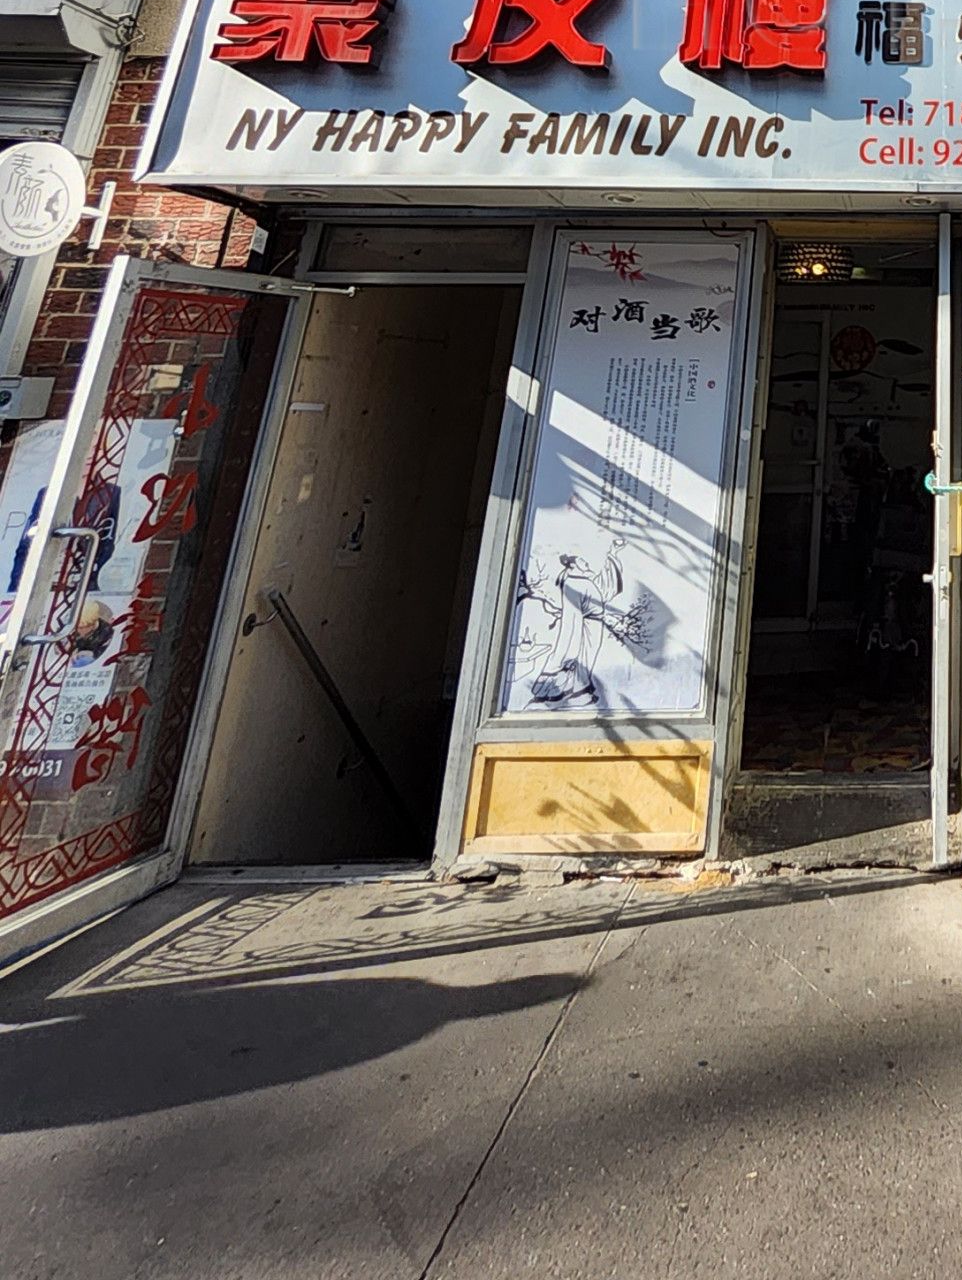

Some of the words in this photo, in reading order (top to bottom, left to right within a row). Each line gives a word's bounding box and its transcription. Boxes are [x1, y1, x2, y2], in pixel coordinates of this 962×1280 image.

[226, 107, 304, 151] NY
[312, 108, 488, 153] HAPPY
[499, 110, 687, 157] FAMILY
[698, 115, 792, 160] INC.
[570, 298, 721, 340] 对酒当歌
